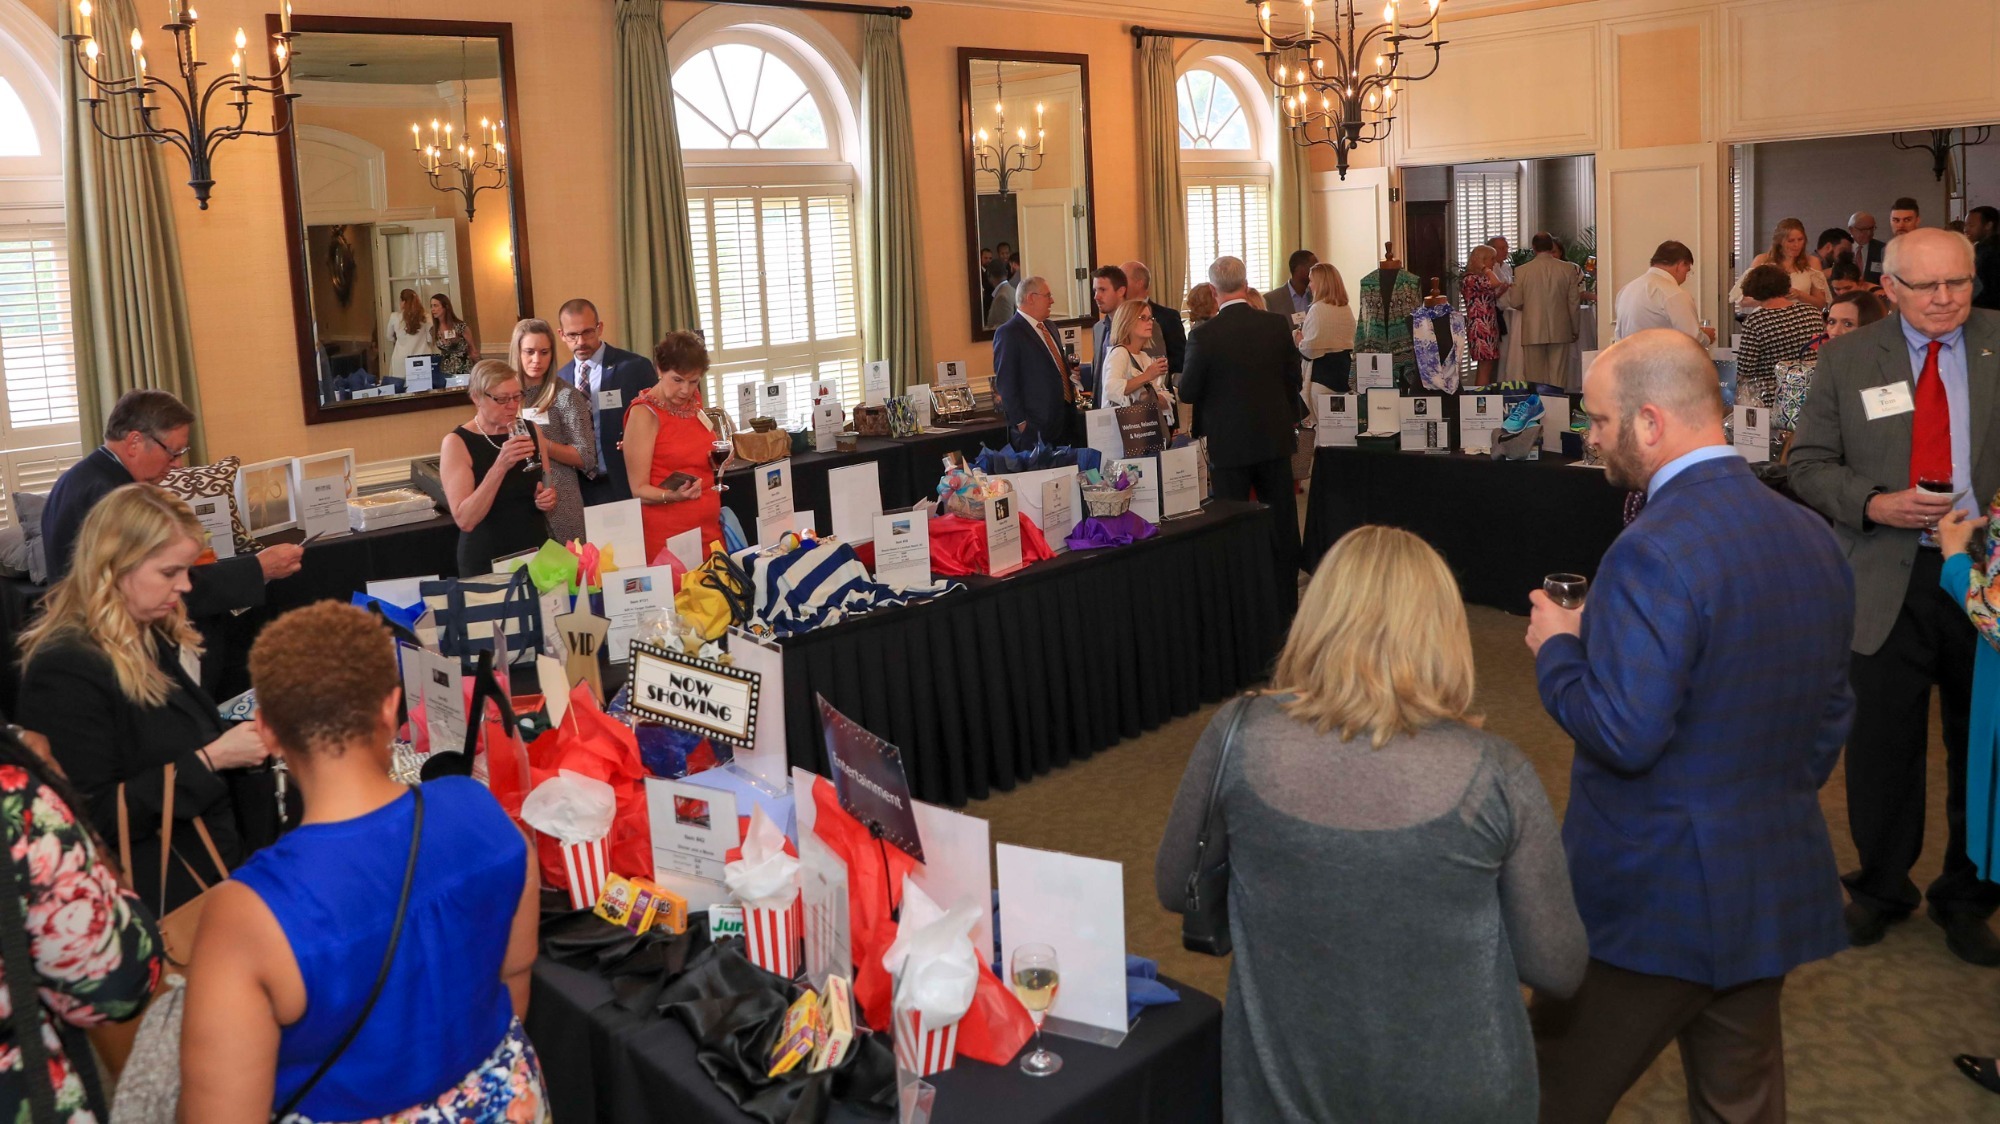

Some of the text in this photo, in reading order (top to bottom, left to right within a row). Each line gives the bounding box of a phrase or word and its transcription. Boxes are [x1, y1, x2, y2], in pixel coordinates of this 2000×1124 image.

[1122, 420, 1158, 431] Wellness, Relaxation
[1134, 430, 1156, 439] Rejuvenation
[567, 631, 595, 656] VIP
[669, 672, 713, 698] NOW
[647, 684, 732, 721] SHOWING
[832, 750, 903, 811] Entertainment
[603, 889, 629, 912] Raisinets
[657, 899, 671, 914] uds
